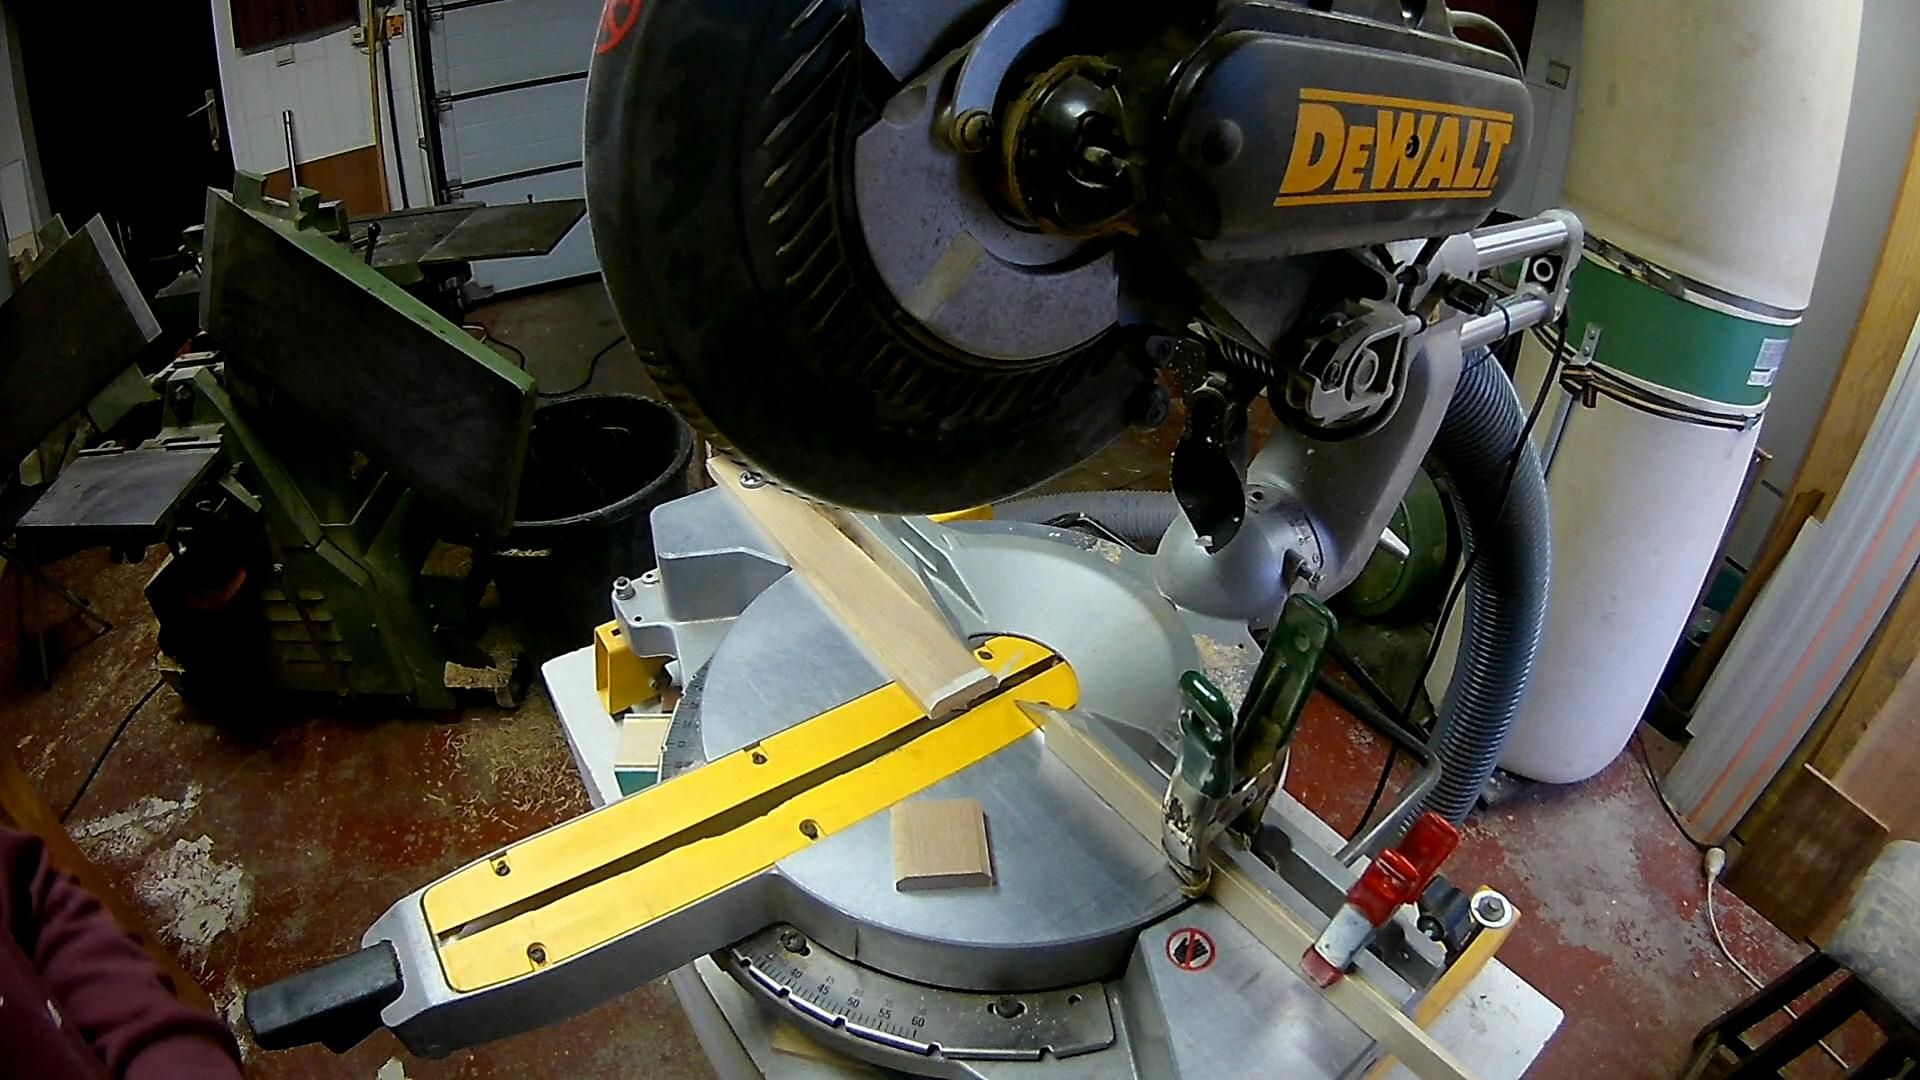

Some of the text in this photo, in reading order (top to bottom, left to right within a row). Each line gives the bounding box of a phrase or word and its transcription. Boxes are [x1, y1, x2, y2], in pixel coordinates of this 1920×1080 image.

[1279, 103, 1512, 193] DEWALT
[817, 983, 831, 995] 45
[847, 996, 861, 1008] 50
[878, 1007, 892, 1020] 55
[911, 1015, 925, 1028] 60
